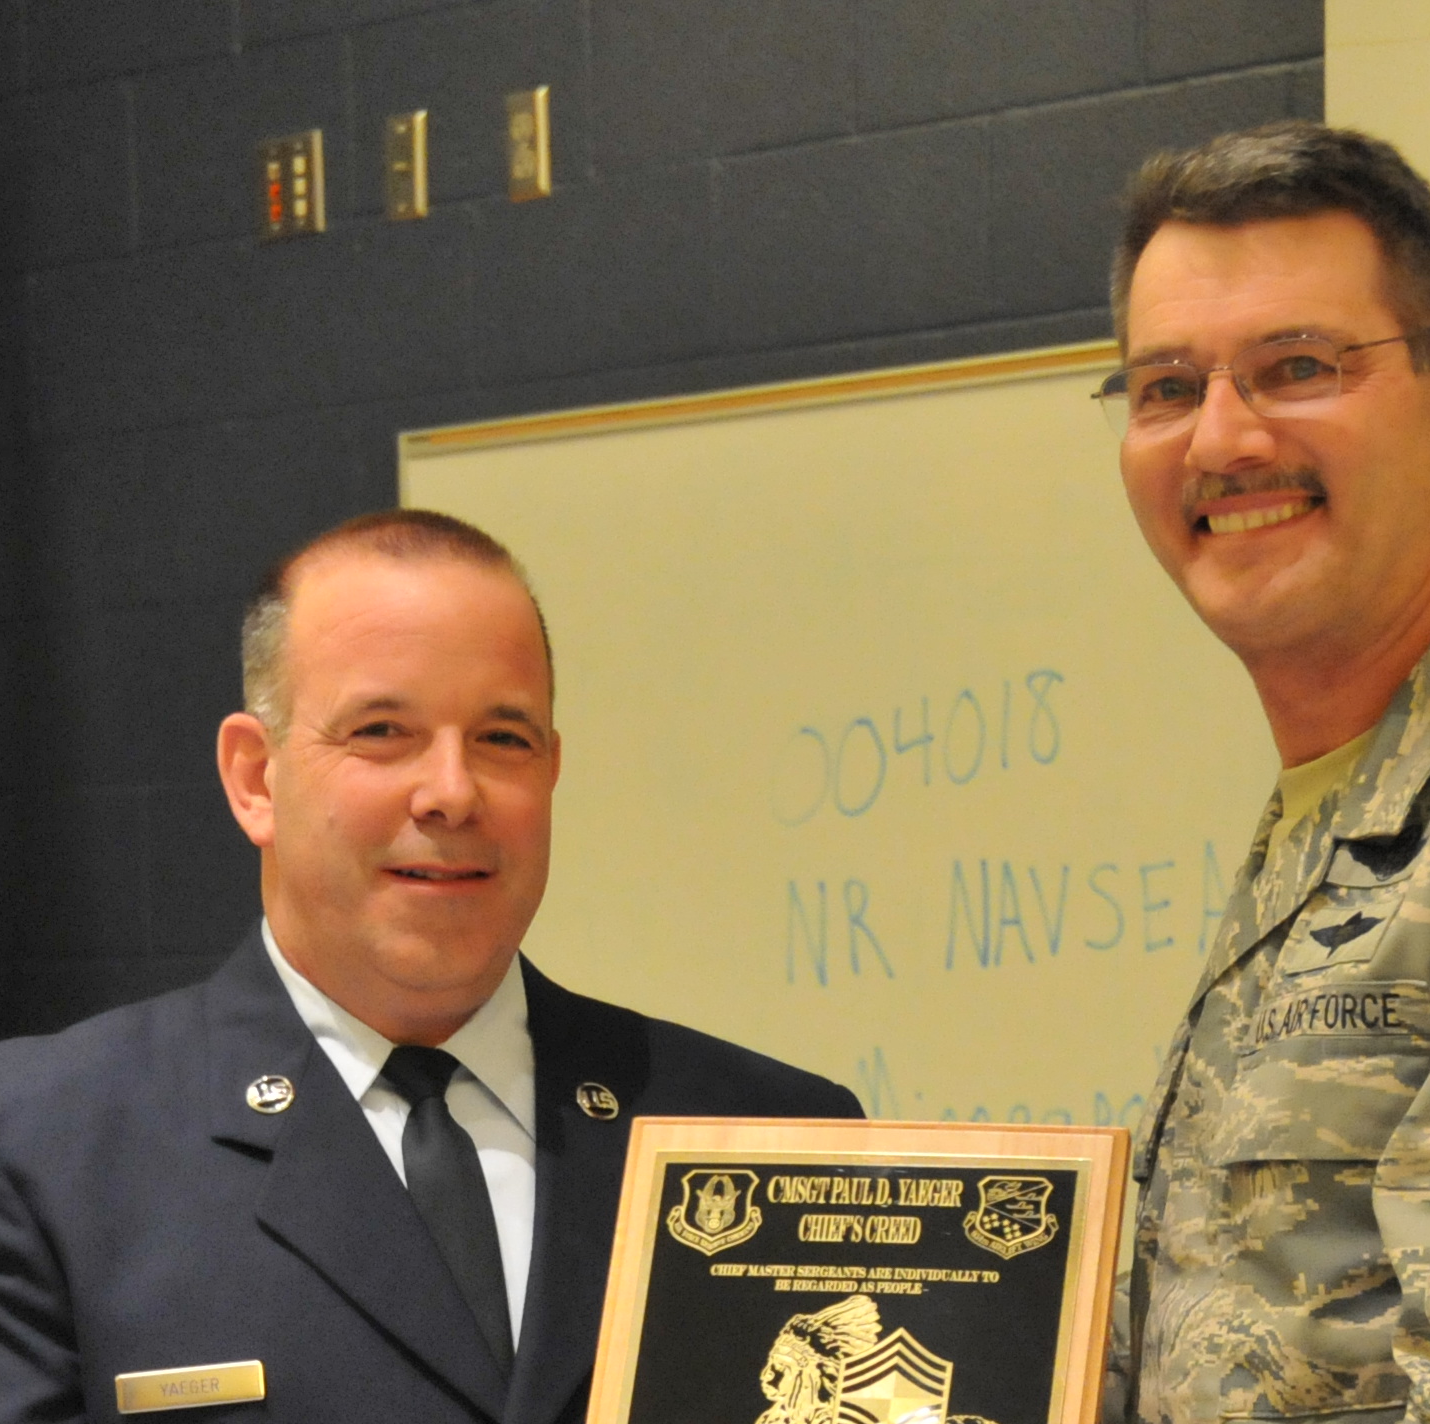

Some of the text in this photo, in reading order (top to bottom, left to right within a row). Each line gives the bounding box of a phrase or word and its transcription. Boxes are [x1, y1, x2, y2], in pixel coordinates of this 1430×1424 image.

[785, 840, 1226, 987] NR NAVSEA
[1279, 997, 1309, 1036] AIR
[1308, 993, 1402, 1030] FORCE
[765, 1175, 965, 1207] CMSGT PAUL D. YAEGER
[796, 1213, 923, 1244] CHIEF'S CREED
[708, 1262, 1001, 1283] CHIEF MASTER SERGEANTS ARE INDIVIDUALLY TO
[773, 1278, 923, 1295] BE REGARDED AS PEOPLE
